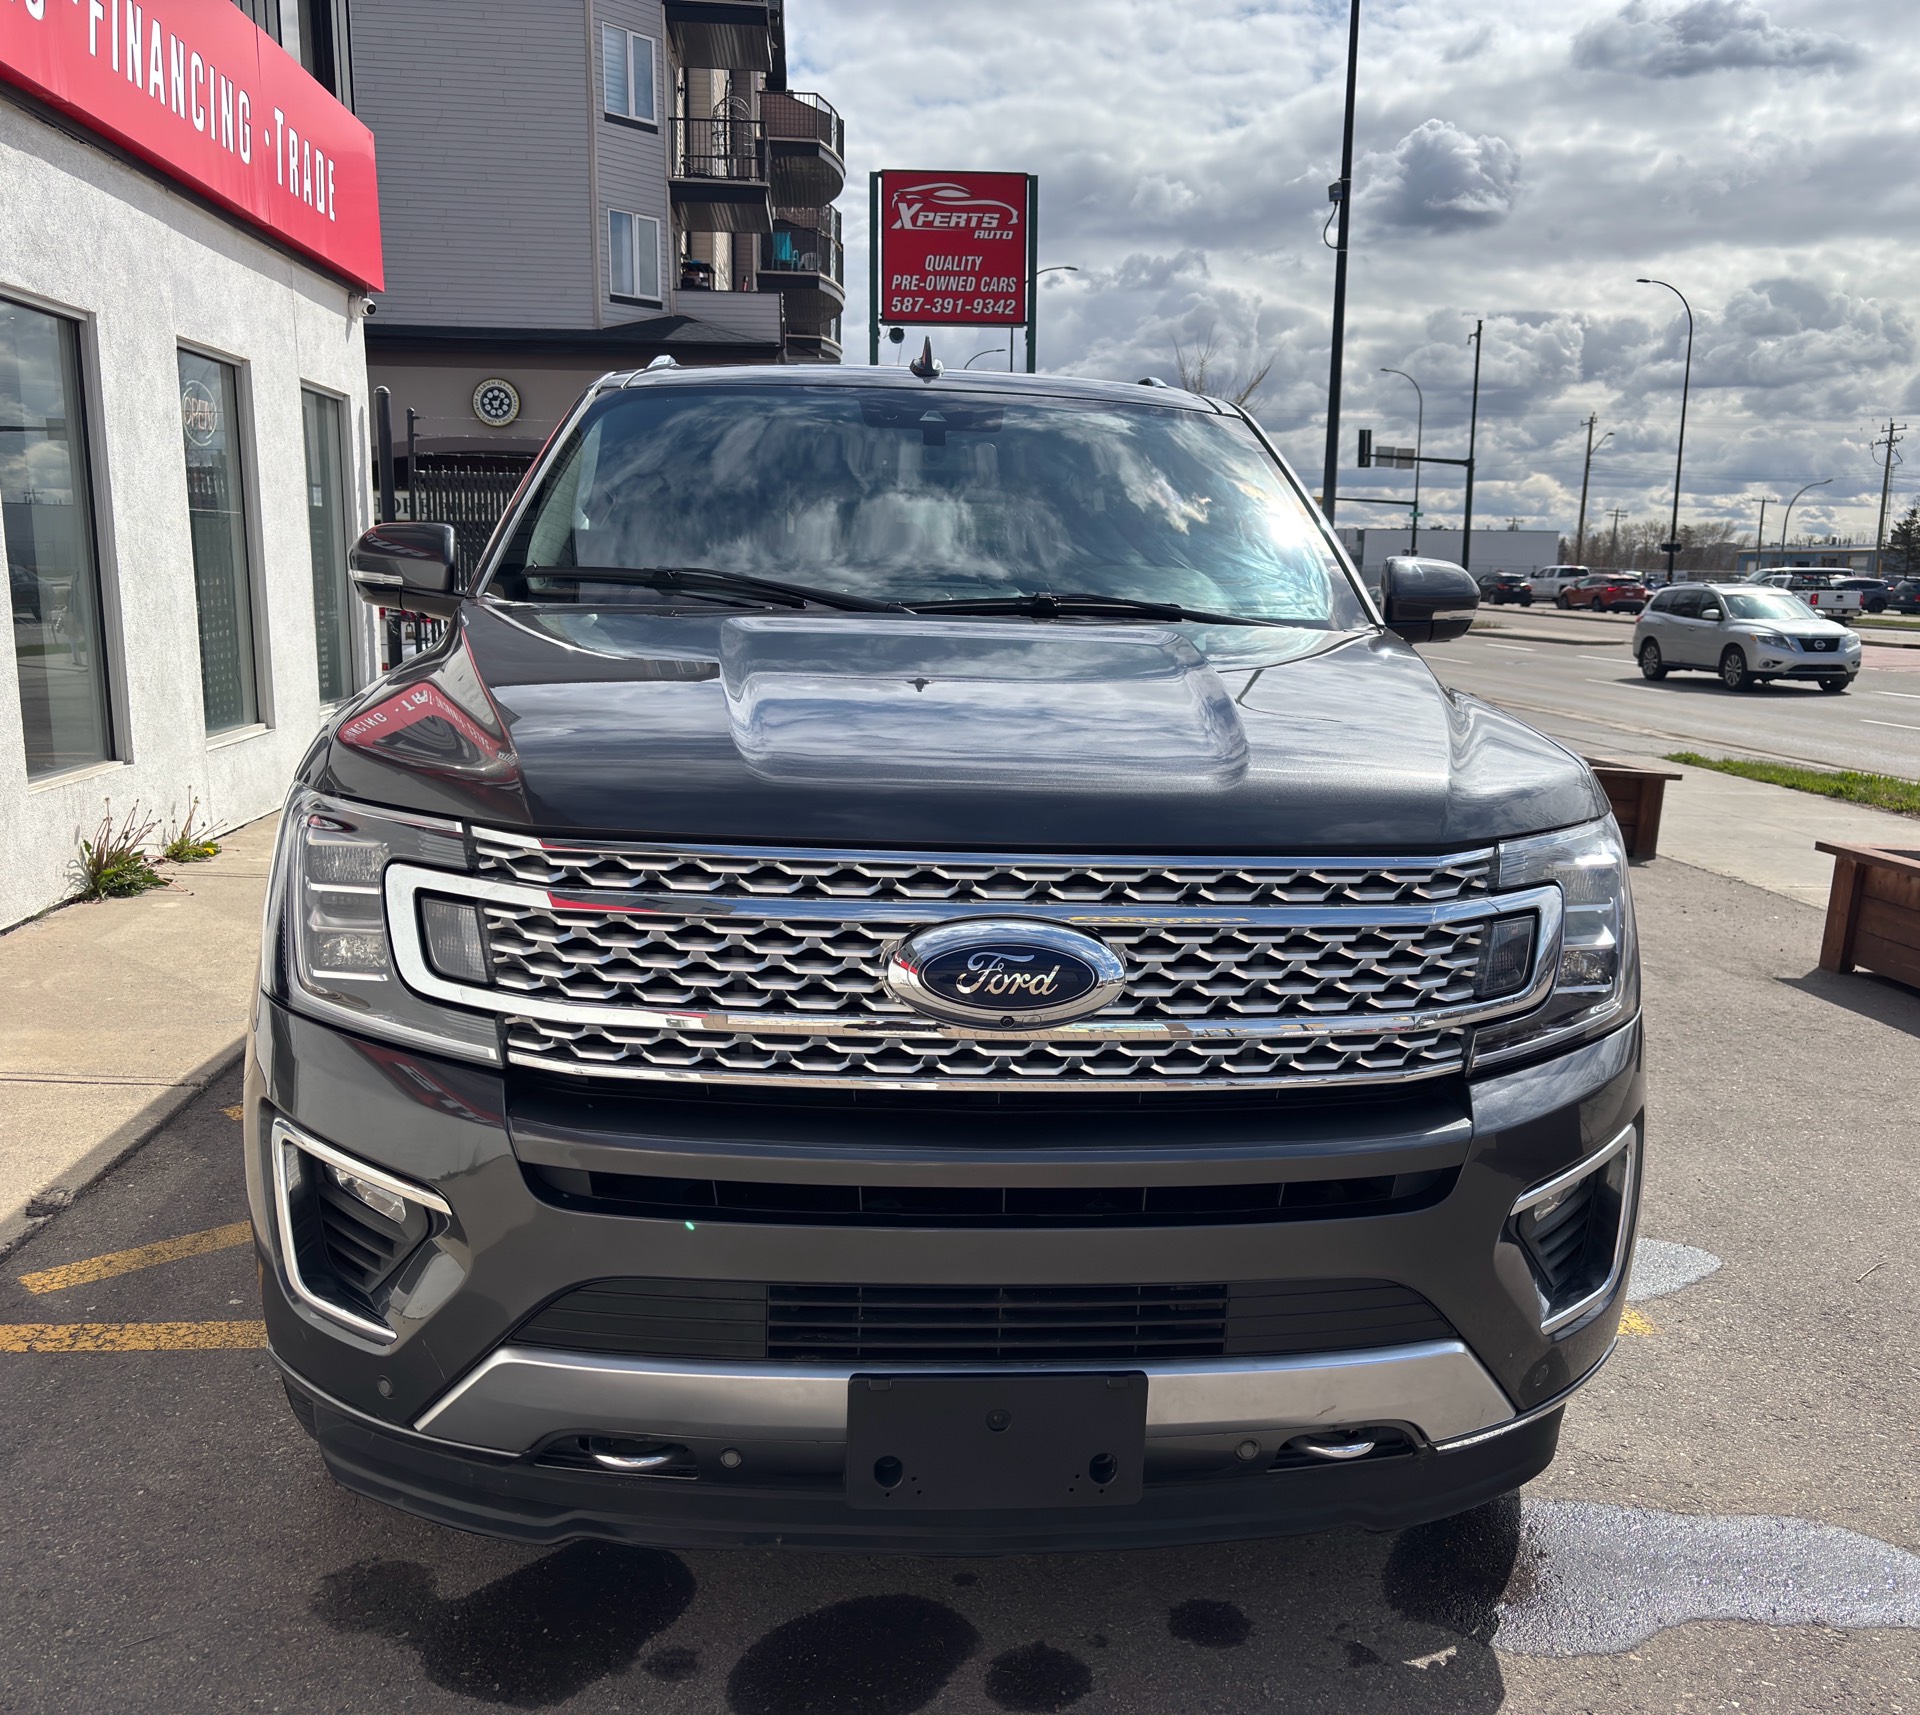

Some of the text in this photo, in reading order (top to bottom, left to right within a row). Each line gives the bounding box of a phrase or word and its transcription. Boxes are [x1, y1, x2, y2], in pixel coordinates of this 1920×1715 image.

[88, 0, 336, 222] FINANCING TRADE
[891, 203, 1000, 230] XPERTS
[973, 230, 1013, 240] AUTO
[925, 255, 983, 271] QUALITY
[892, 275, 1017, 293] PRE-OWNED CARS
[891, 297, 1016, 315] 587-391-9342
[955, 951, 1061, 996] Ford
